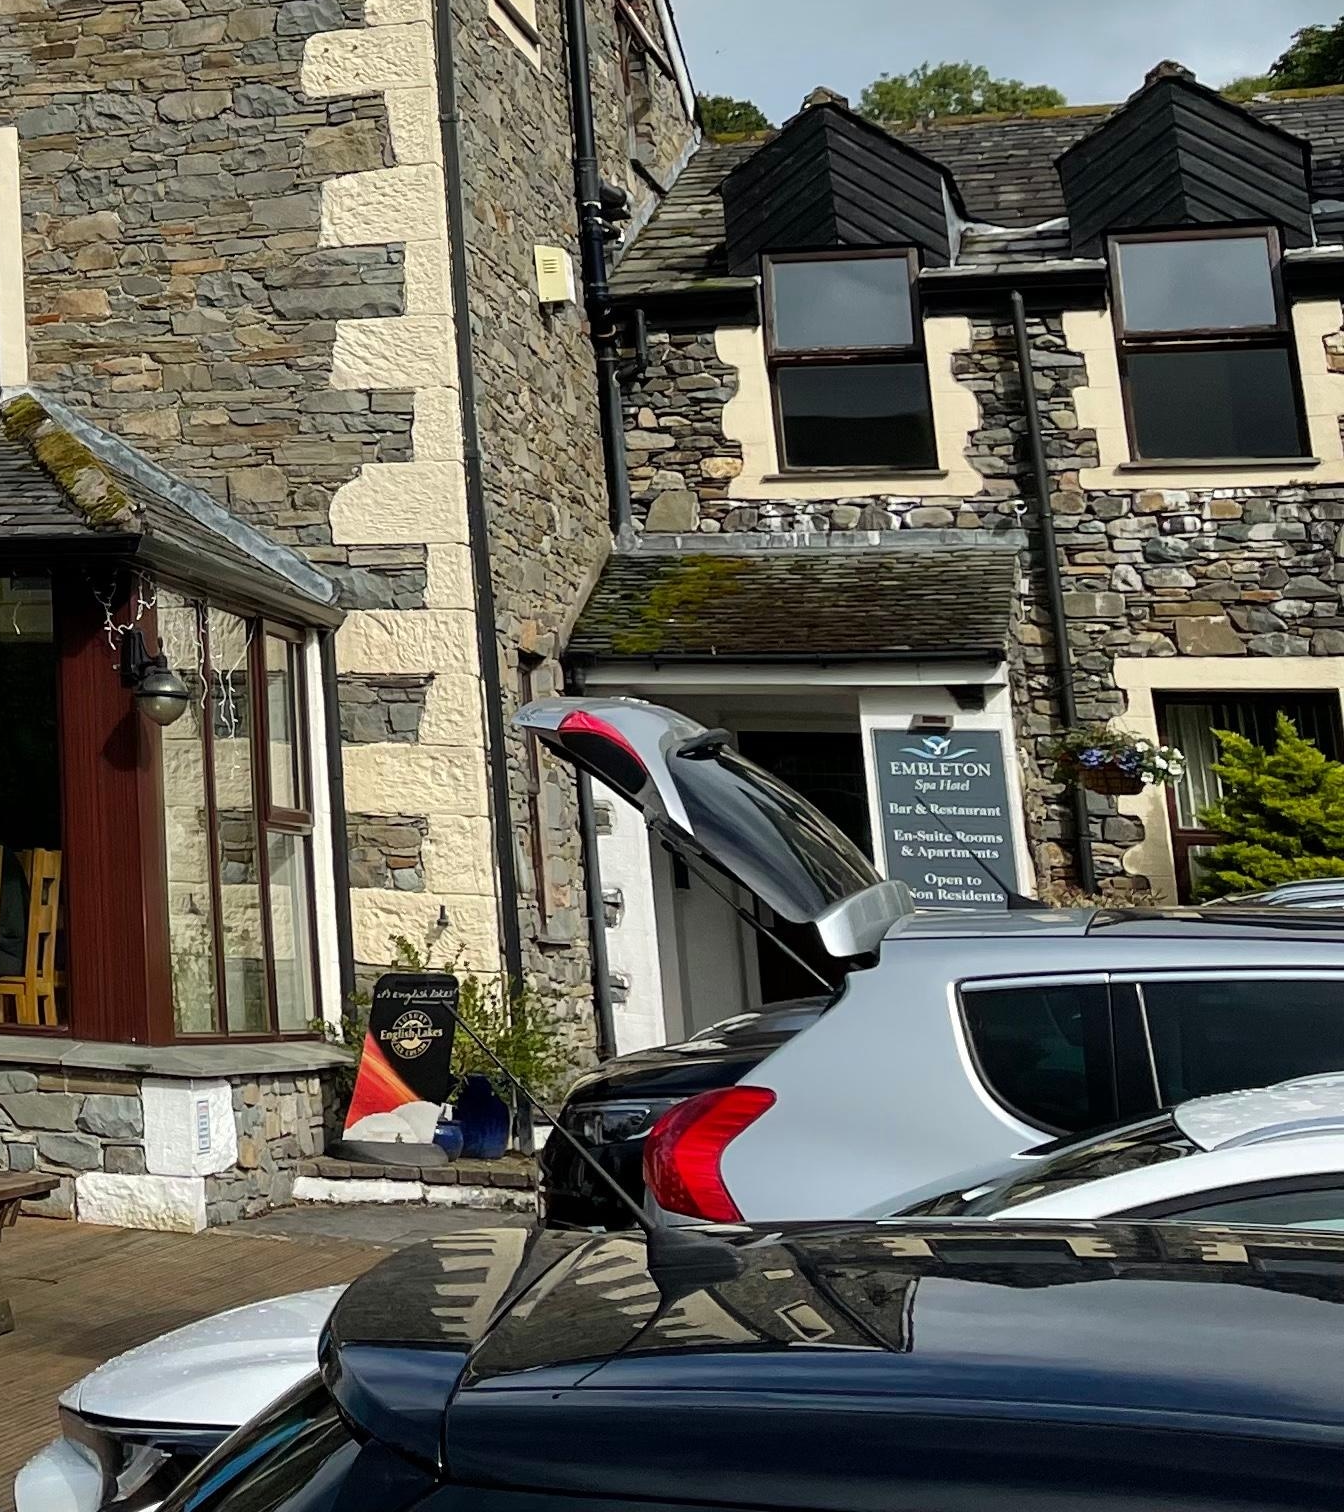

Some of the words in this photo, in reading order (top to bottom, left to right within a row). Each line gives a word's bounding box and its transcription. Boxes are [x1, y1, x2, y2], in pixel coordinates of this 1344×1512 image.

[890, 761, 991, 777] EMBLETON
[914, 779, 937, 793] Spa
[939, 779, 970, 791] Hotel
[889, 803, 913, 815] Bar
[914, 803, 928, 815] &
[929, 803, 1002, 817] Restaurant
[893, 829, 954, 843] En-Suite
[955, 830, 1004, 844] Rooms
[901, 845, 915, 857] &
[924, 872, 963, 887] Open
[967, 876, 982, 886] to
[938, 889, 1005, 903] Residents
[380, 1029, 415, 1041] English
[417, 1028, 443, 1038] Lakes
